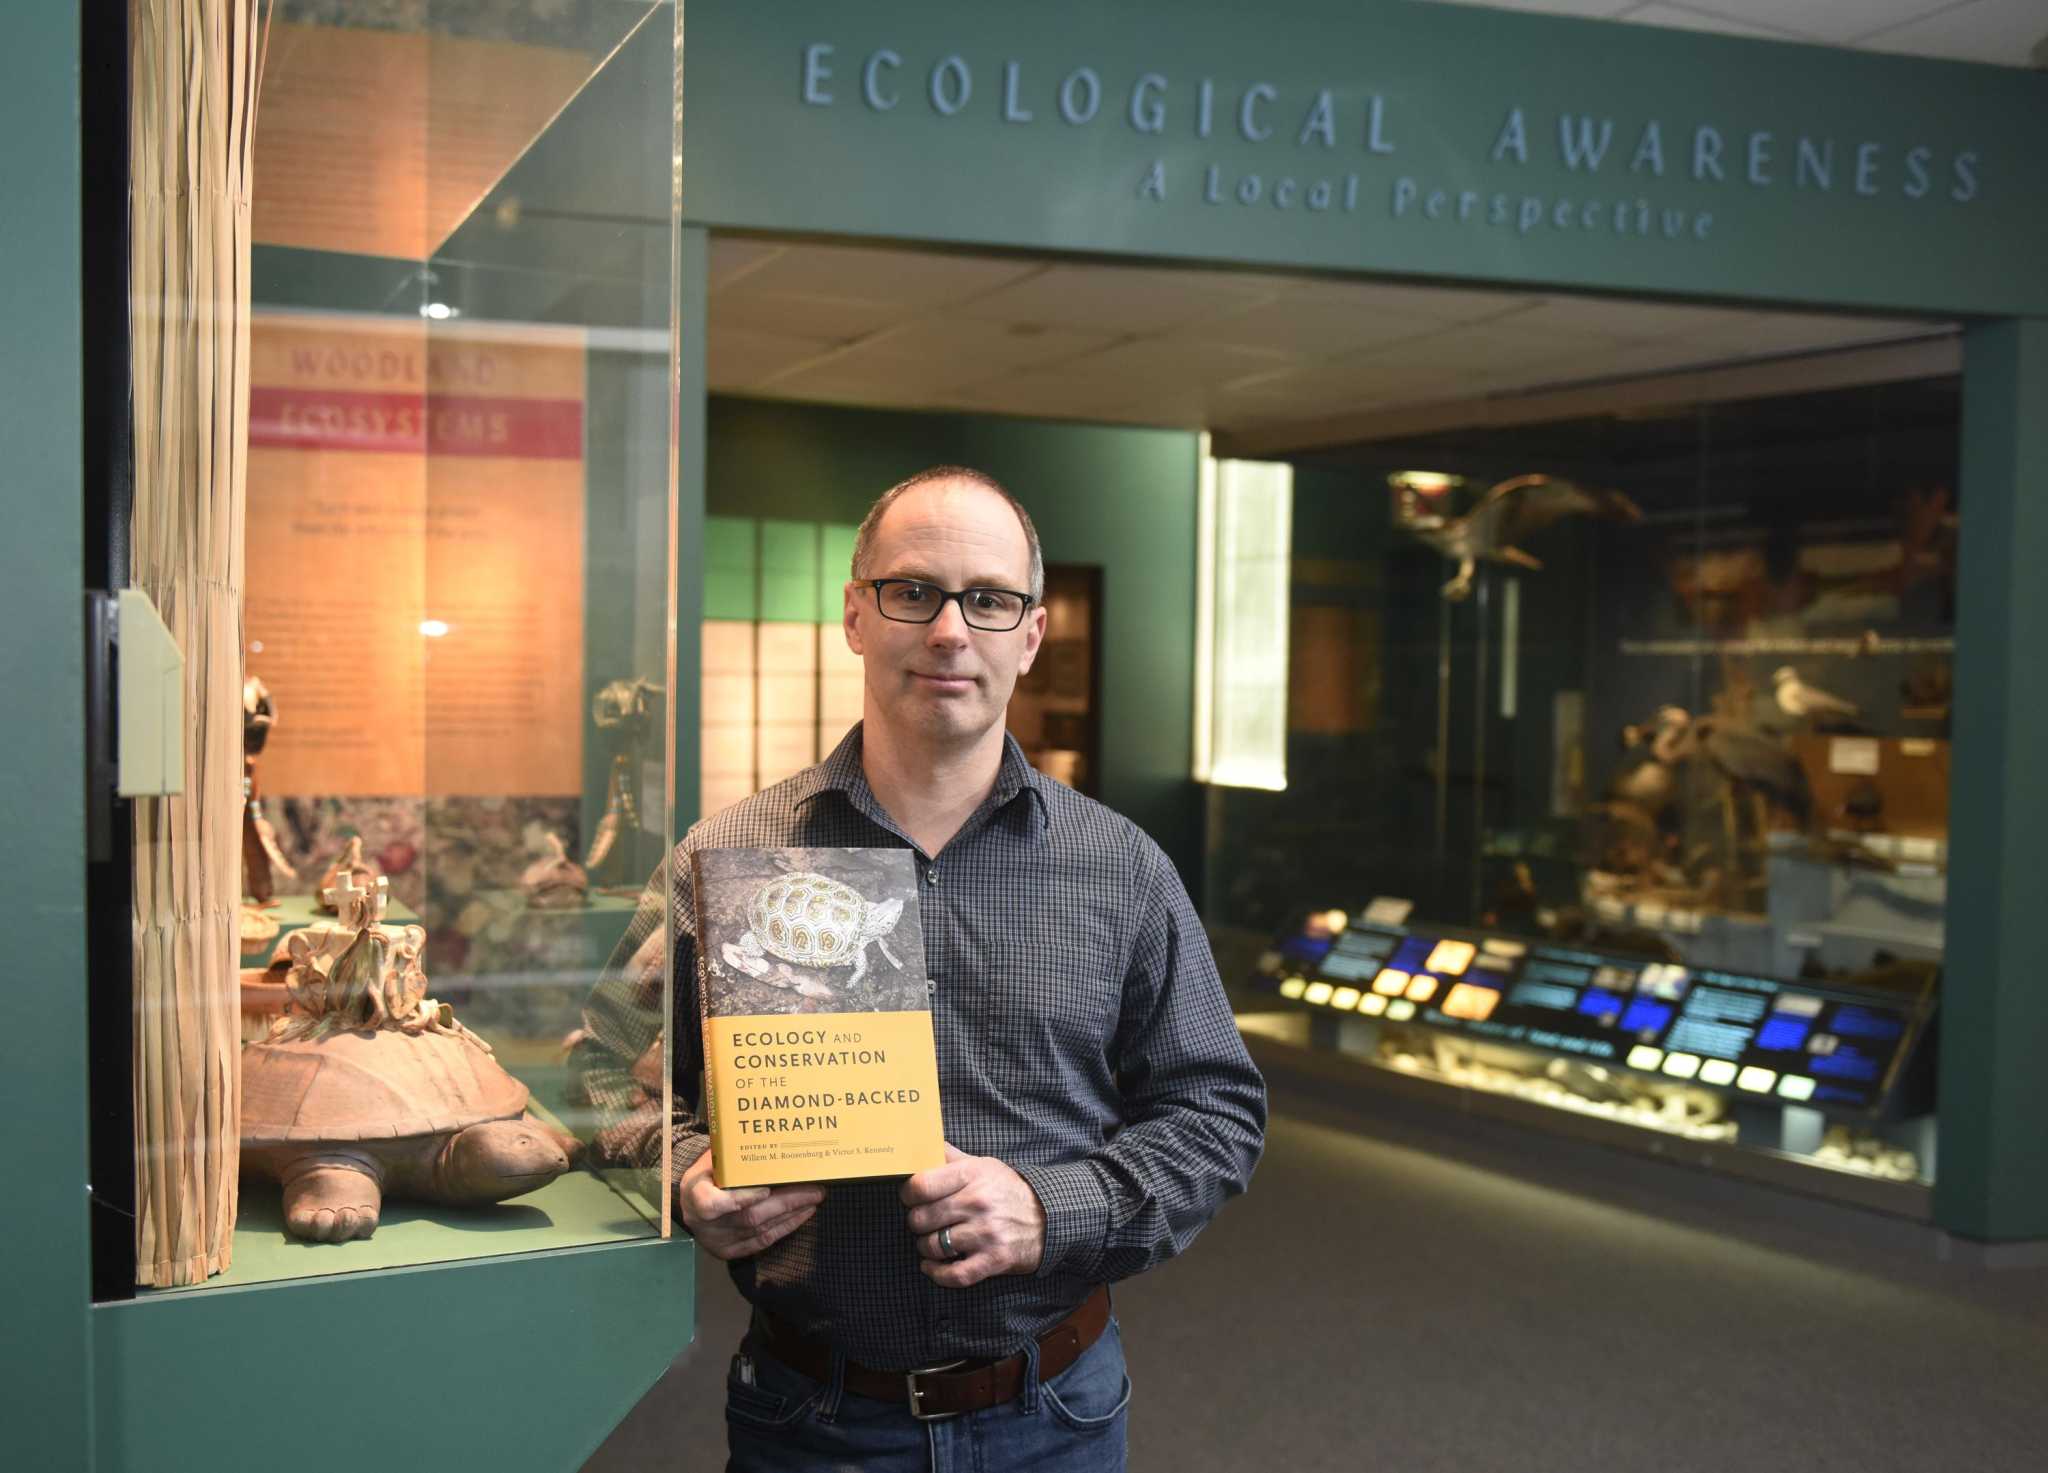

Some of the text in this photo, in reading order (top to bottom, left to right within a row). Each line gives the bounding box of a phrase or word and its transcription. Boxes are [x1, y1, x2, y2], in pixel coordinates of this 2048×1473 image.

[803, 42, 1980, 201] ECOLOGICAL AWARENESS
[1141, 161, 1714, 239] A Local Perspective
[280, 404, 509, 444] ECOSYSEMS
[733, 1031, 862, 1047] ECOLOGY AND
[734, 1050, 886, 1069] CONSERVATION
[735, 1076, 788, 1089] OF THE
[738, 1089, 920, 1112] DIAMOND-BACKED
[738, 1115, 838, 1134] TERRAPIN
[740, 1143, 767, 1151] EDITED
[740, 1153, 767, 1162] Willem
[768, 1152, 779, 1161] M.
